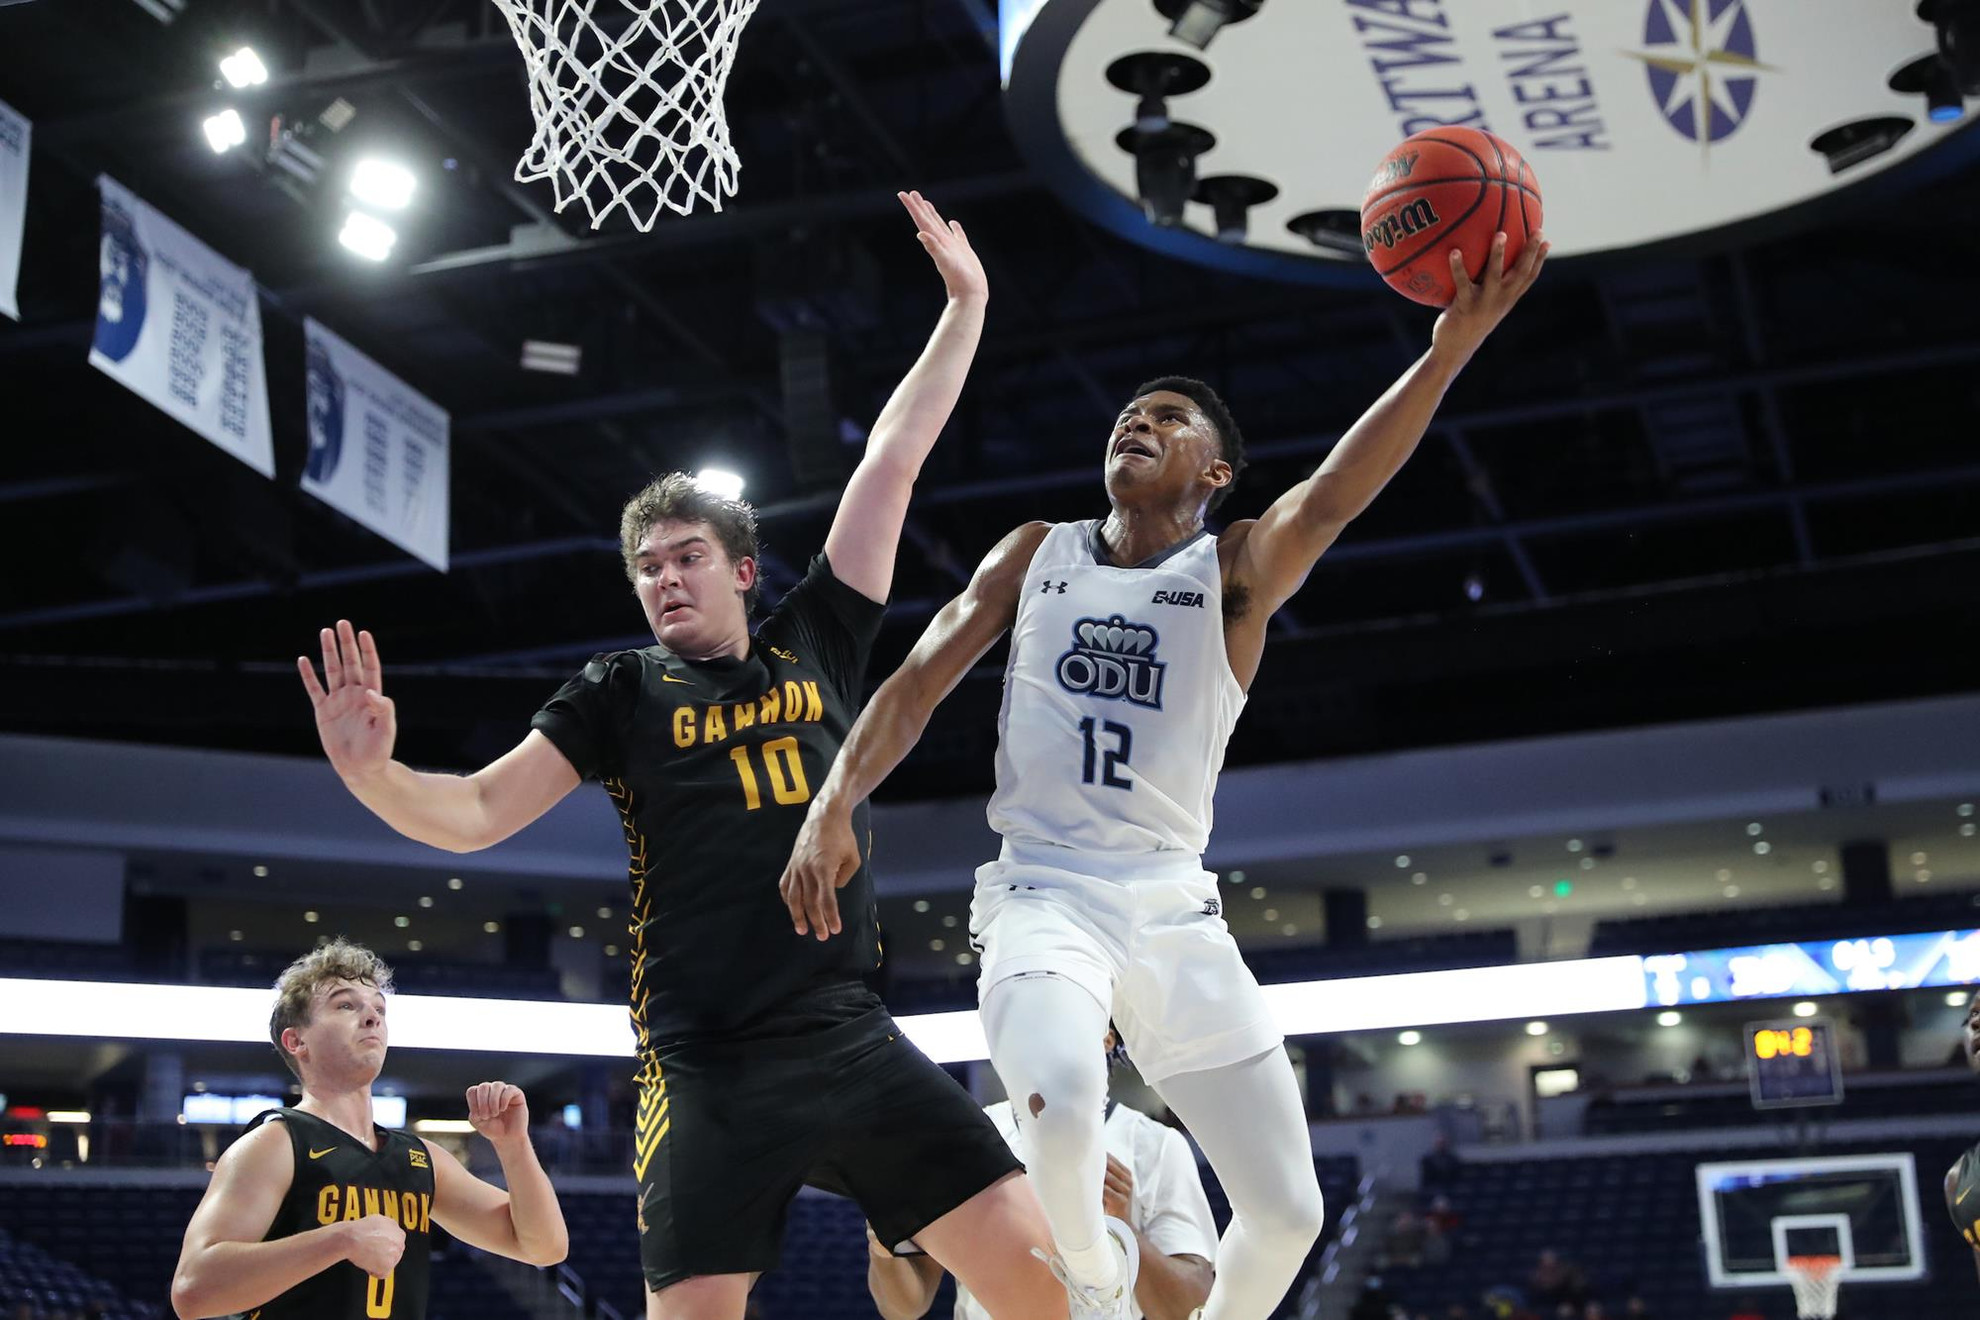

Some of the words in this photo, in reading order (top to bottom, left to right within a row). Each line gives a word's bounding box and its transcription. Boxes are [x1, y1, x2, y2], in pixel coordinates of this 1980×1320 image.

[1491, 12, 1613, 151] ARENA
[672, 680, 824, 748] GANNON
[1056, 651, 1167, 710] ODU
[729, 736, 811, 811] 10
[1078, 715, 1134, 791] 12
[317, 1184, 431, 1234] GANNON
